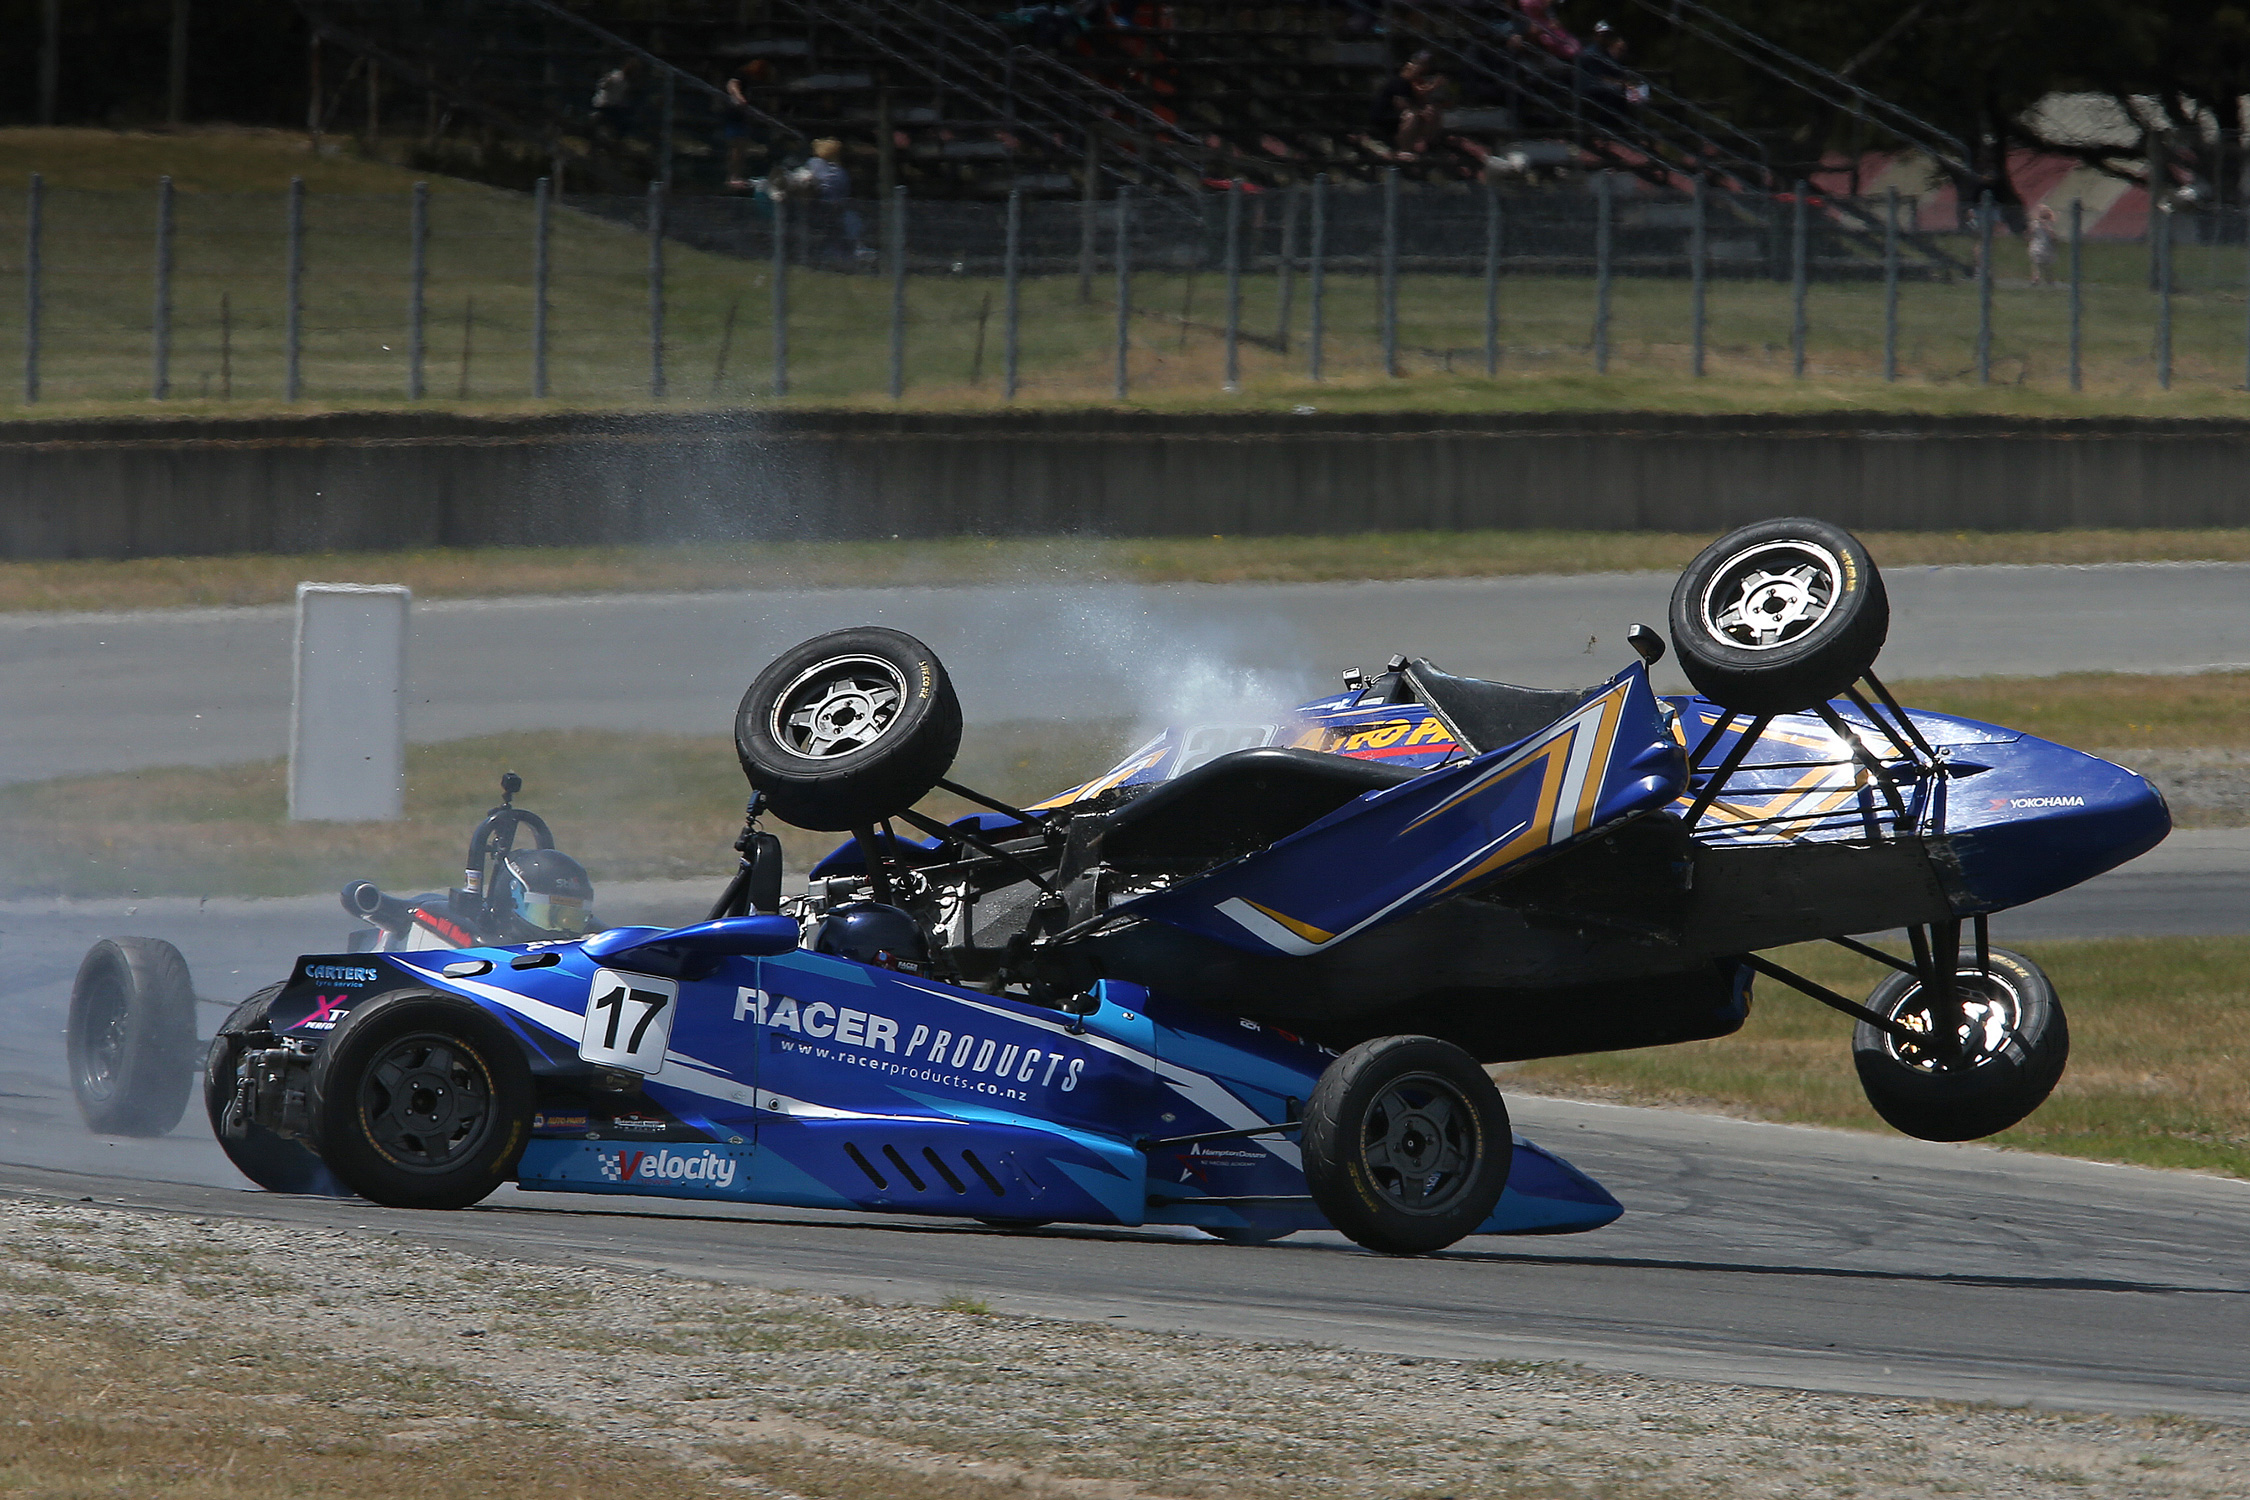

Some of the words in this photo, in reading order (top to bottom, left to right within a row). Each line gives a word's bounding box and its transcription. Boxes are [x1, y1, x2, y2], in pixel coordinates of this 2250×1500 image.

[2010, 796, 2085, 809] YOKOHAMA
[305, 964, 378, 981] CARTER'S
[595, 986, 669, 1055] 17
[733, 986, 899, 1054] RACER
[904, 1024, 1085, 1092] PRODUCTS
[780, 1040, 1028, 1102] www.racerproducts.co.nz
[618, 1149, 737, 1188] Velocity
